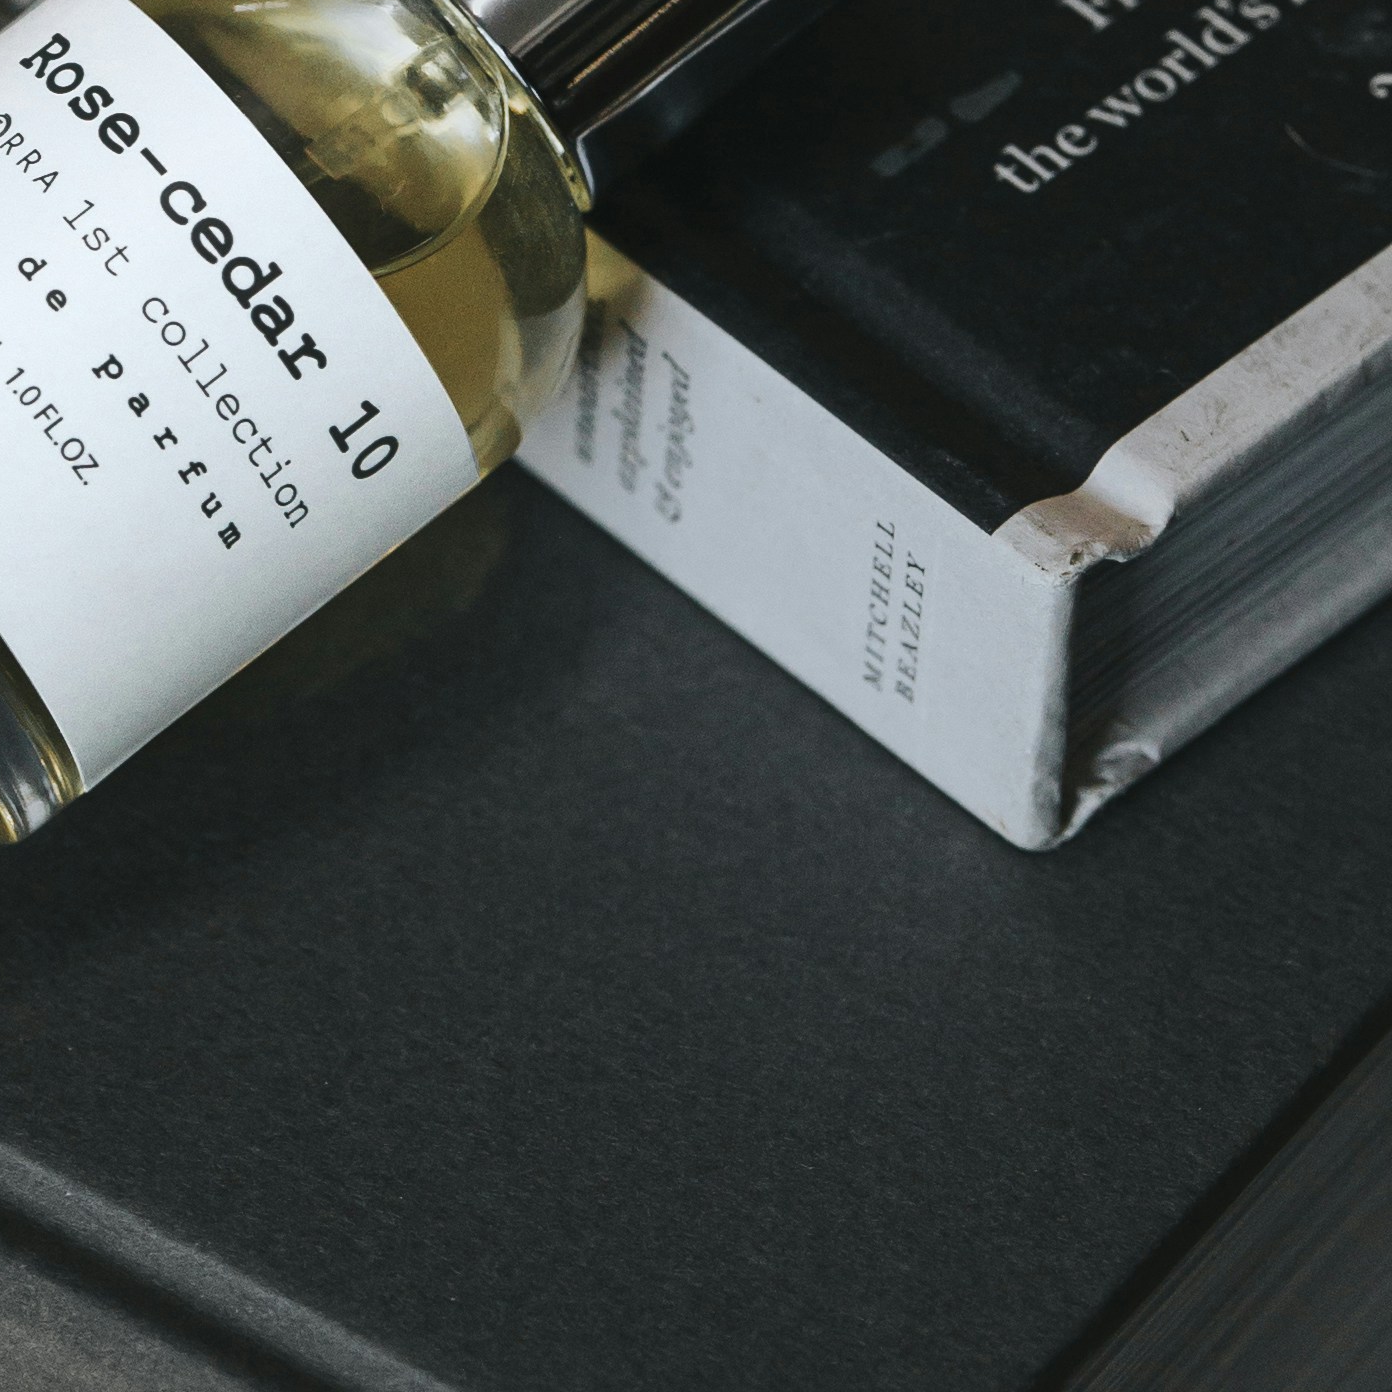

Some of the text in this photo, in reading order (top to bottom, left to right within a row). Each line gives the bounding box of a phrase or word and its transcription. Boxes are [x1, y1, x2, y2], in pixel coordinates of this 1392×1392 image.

[19, 33, 400, 481] Rose-cedar 10
[994, 121, 1098, 194] the
[18, 256, 68, 312] de
[91, 353, 242, 550] parfum
[63, 200, 130, 277] 1st
[142, 297, 310, 529] collection
[863, 519, 896, 693] MITCHELL
[894, 549, 926, 704] BEAZLEY
